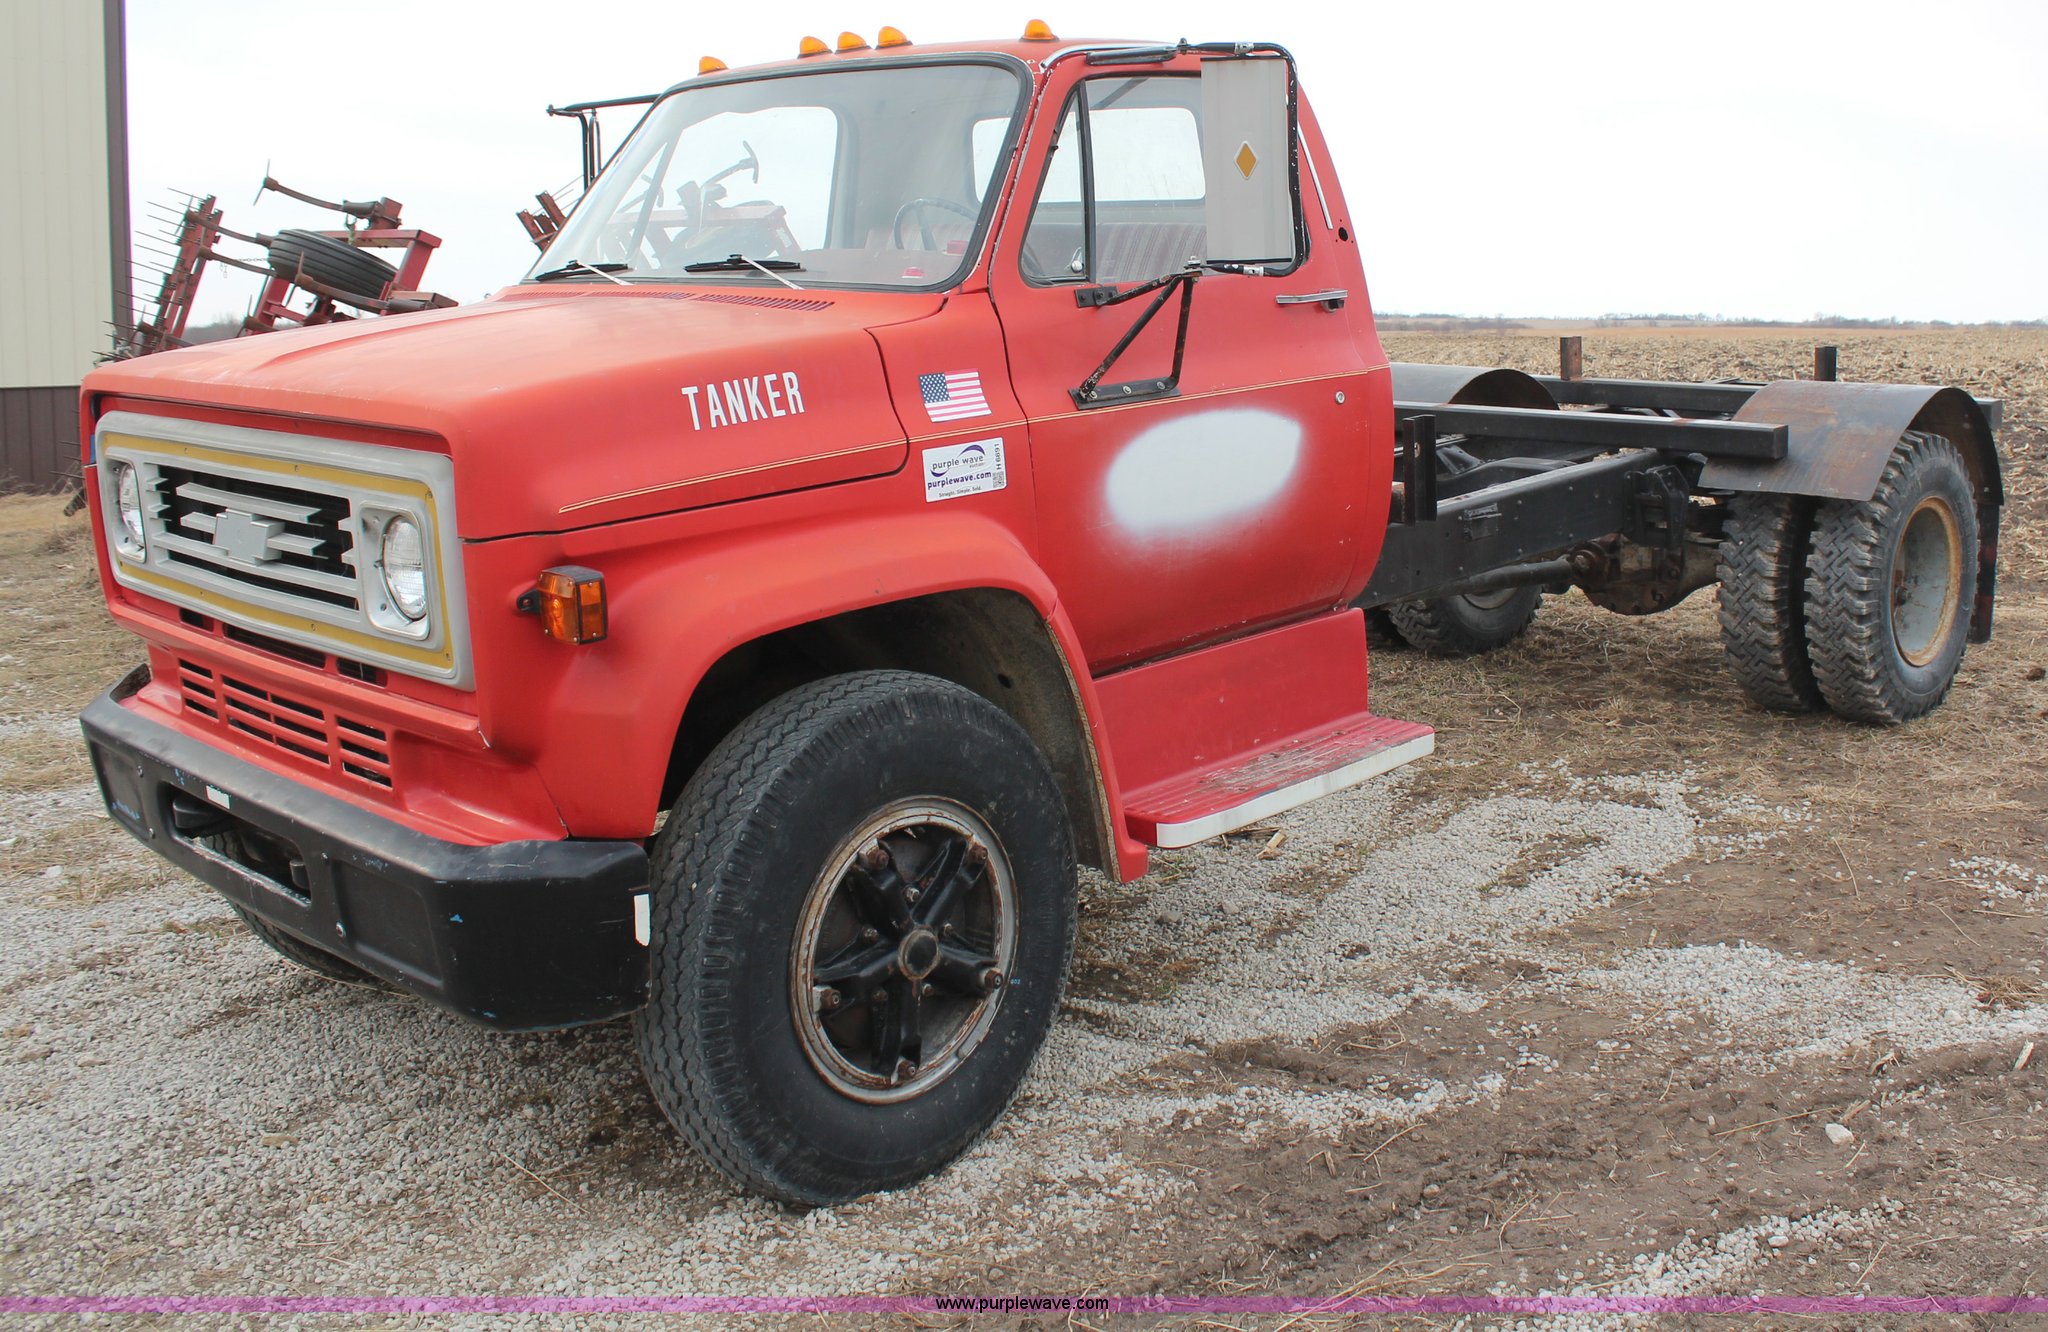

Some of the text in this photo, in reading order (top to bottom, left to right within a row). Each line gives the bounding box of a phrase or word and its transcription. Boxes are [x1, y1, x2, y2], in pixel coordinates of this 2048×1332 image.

[681, 371, 805, 431] TANKER
[932, 458, 959, 471] purple
[962, 455, 984, 464] wave
[927, 471, 992, 490] purplewave.com
